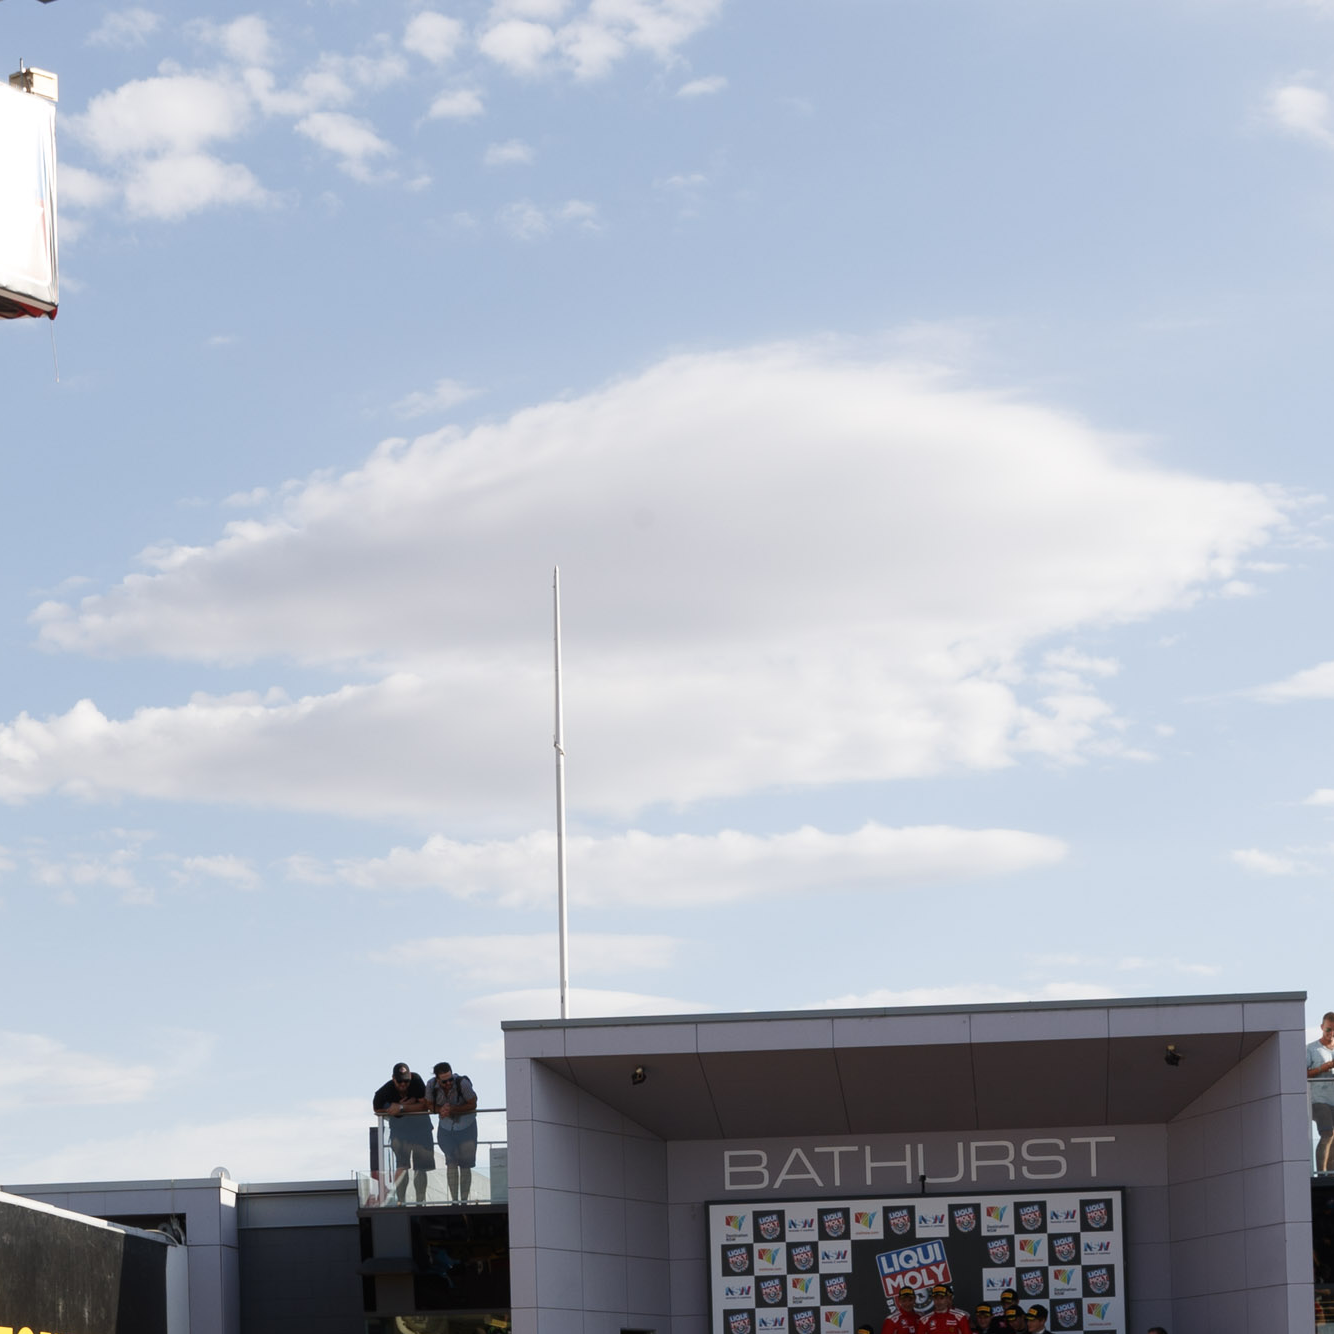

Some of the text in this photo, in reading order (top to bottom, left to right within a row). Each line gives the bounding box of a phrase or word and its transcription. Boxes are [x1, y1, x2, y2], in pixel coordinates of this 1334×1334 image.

[723, 1136, 1116, 1191] BATHURST
[919, 1214, 944, 1225] NSW
[1051, 1210, 1076, 1220] NSW
[789, 1218, 814, 1229] NSW
[1085, 1242, 1110, 1252] NSW
[821, 1250, 847, 1261] NSW
[880, 1243, 943, 1274] LIQUI
[885, 1263, 946, 1295] MOLY
[725, 1286, 751, 1296] NSW
[759, 1316, 785, 1327] NSW
